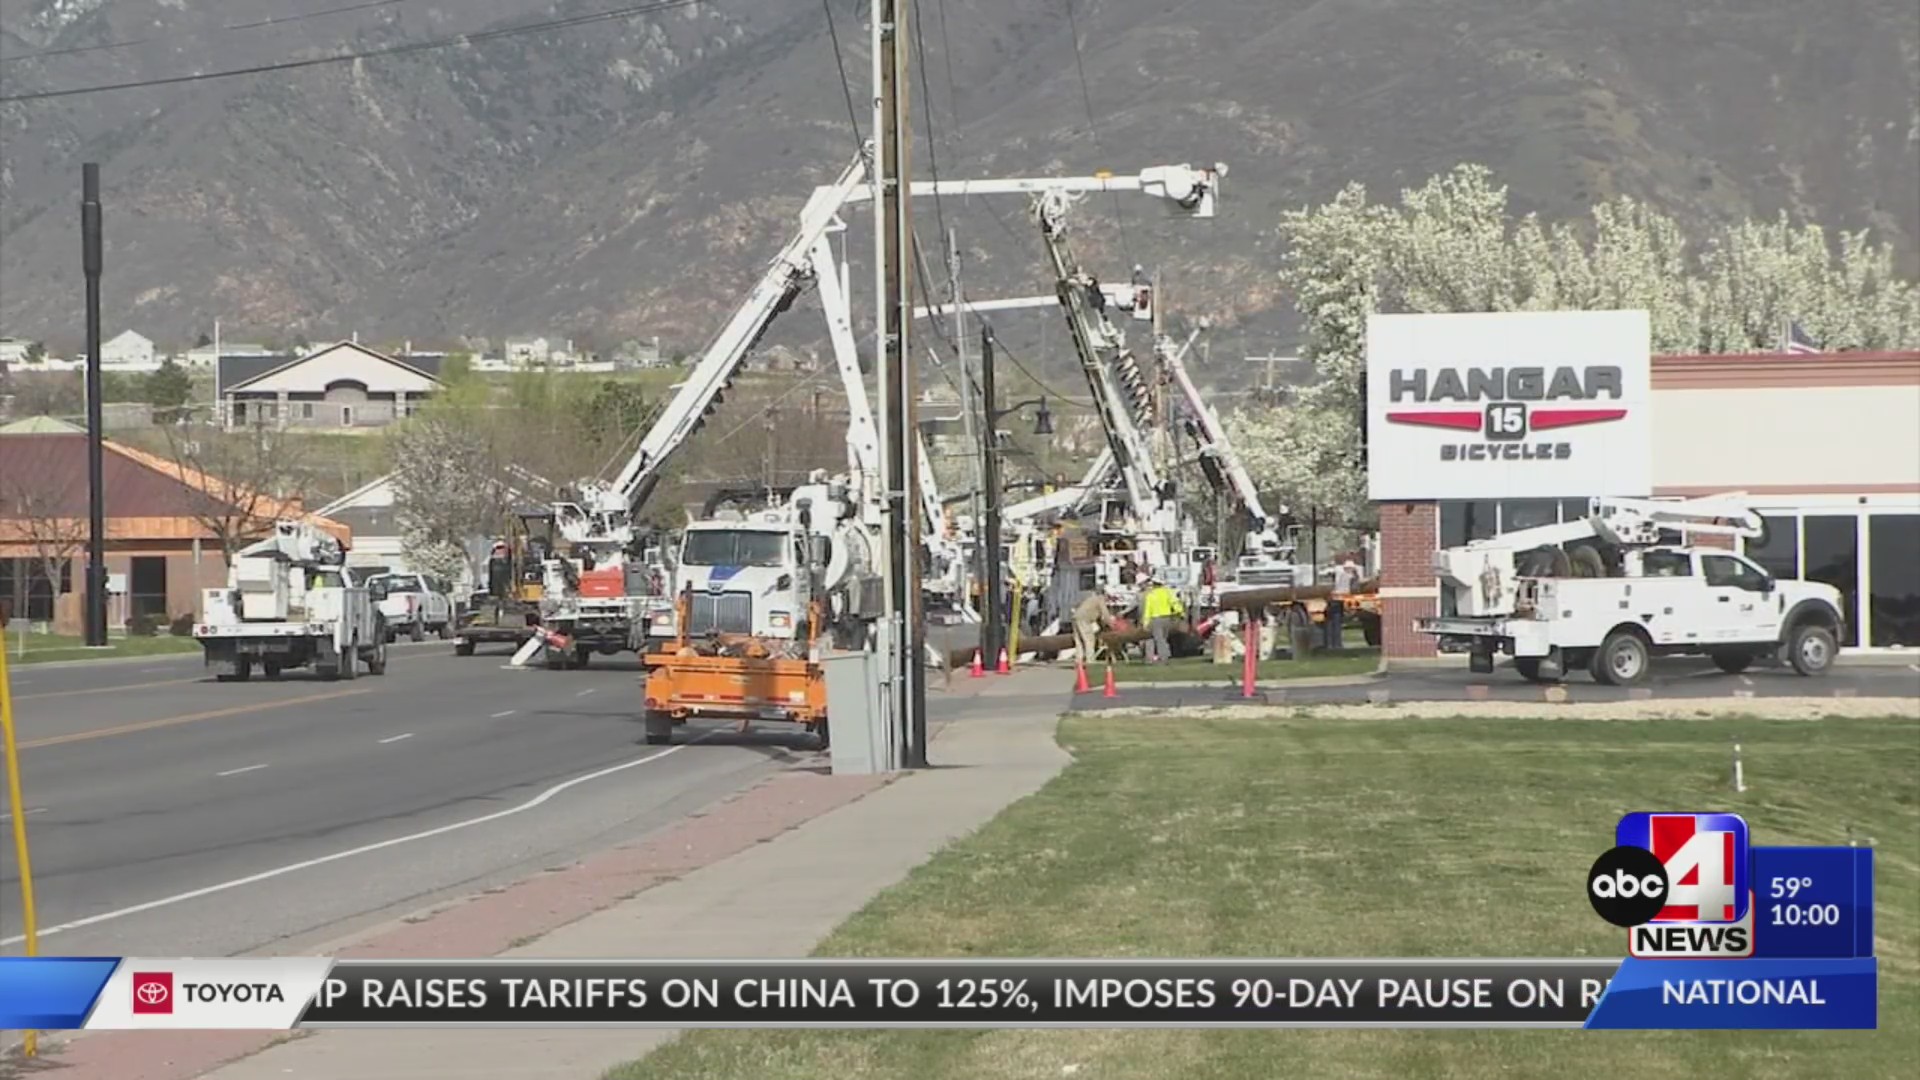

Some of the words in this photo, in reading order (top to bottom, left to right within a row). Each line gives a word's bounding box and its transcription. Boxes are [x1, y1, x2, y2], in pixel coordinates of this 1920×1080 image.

[1389, 365, 1623, 403] HANGAR
[1490, 407, 1523, 433] 15
[1440, 442, 1572, 461] BICYCLES
